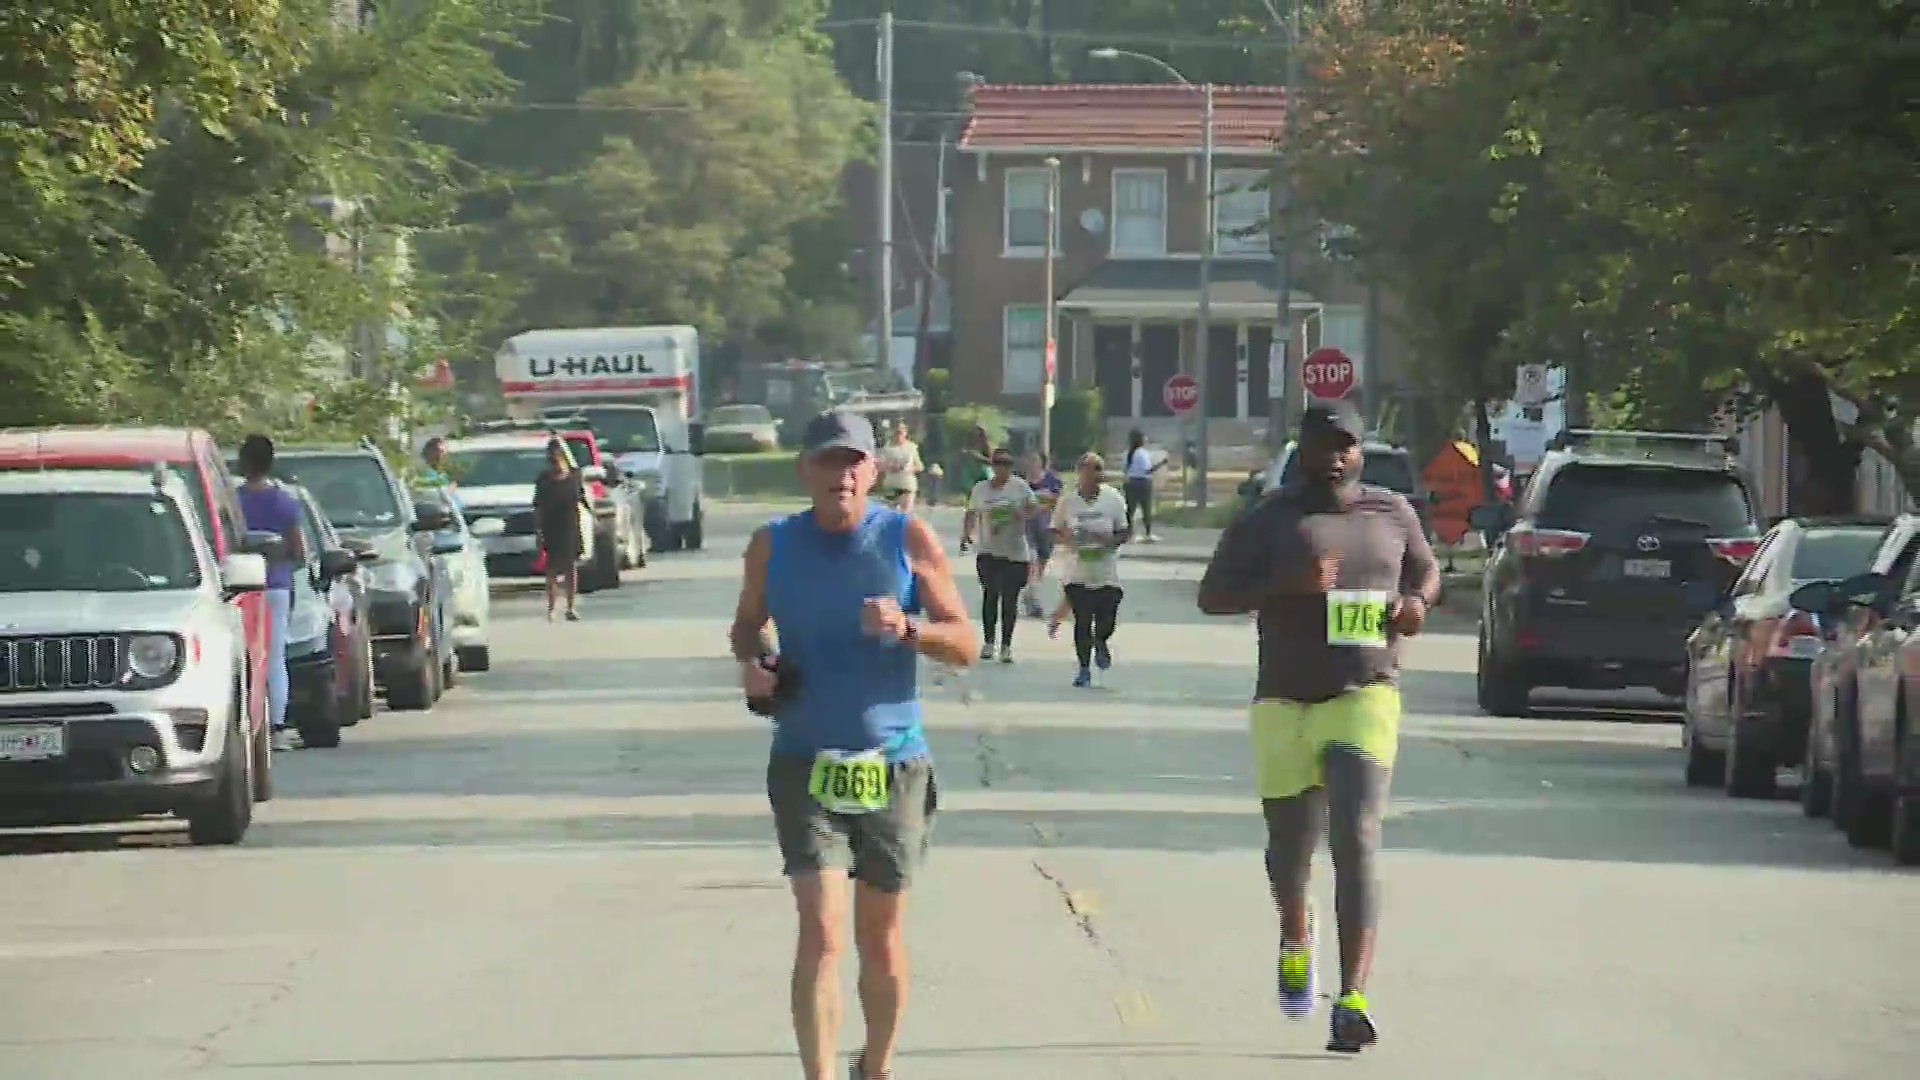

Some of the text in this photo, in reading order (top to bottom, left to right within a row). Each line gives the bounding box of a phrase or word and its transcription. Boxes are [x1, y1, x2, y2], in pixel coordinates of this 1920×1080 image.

[529, 353, 653, 377] U-HAUL
[1305, 363, 1350, 384] STOP
[1166, 386, 1197, 400] STOP
